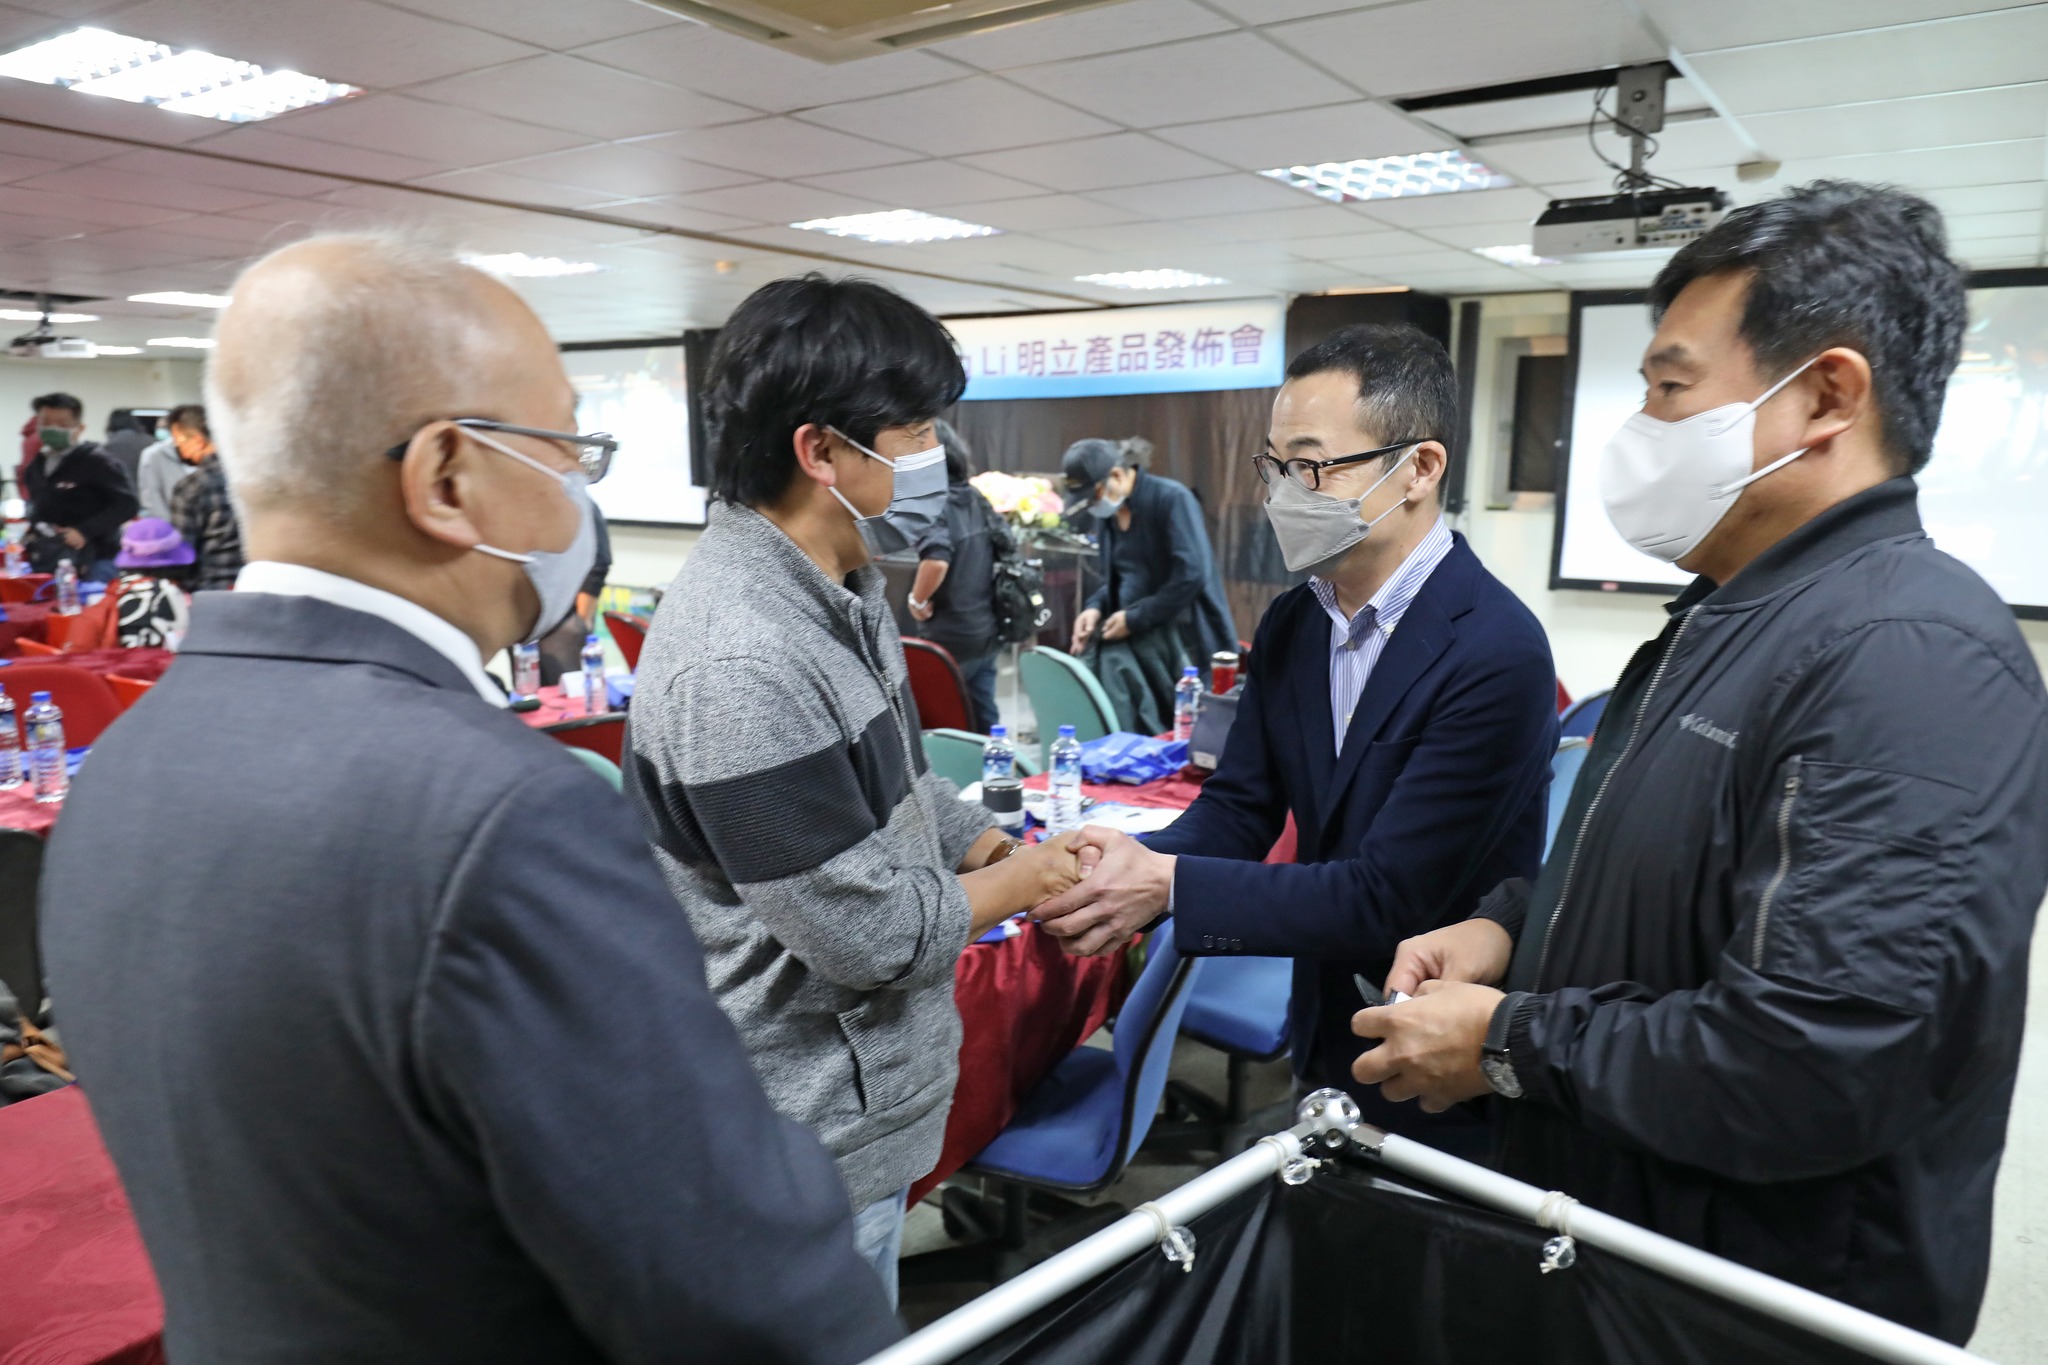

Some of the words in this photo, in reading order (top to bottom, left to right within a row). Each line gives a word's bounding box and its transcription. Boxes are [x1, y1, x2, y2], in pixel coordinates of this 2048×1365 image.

[982, 346, 1006, 375] Li
[1017, 323, 1265, 377] 明立產品發佈會
